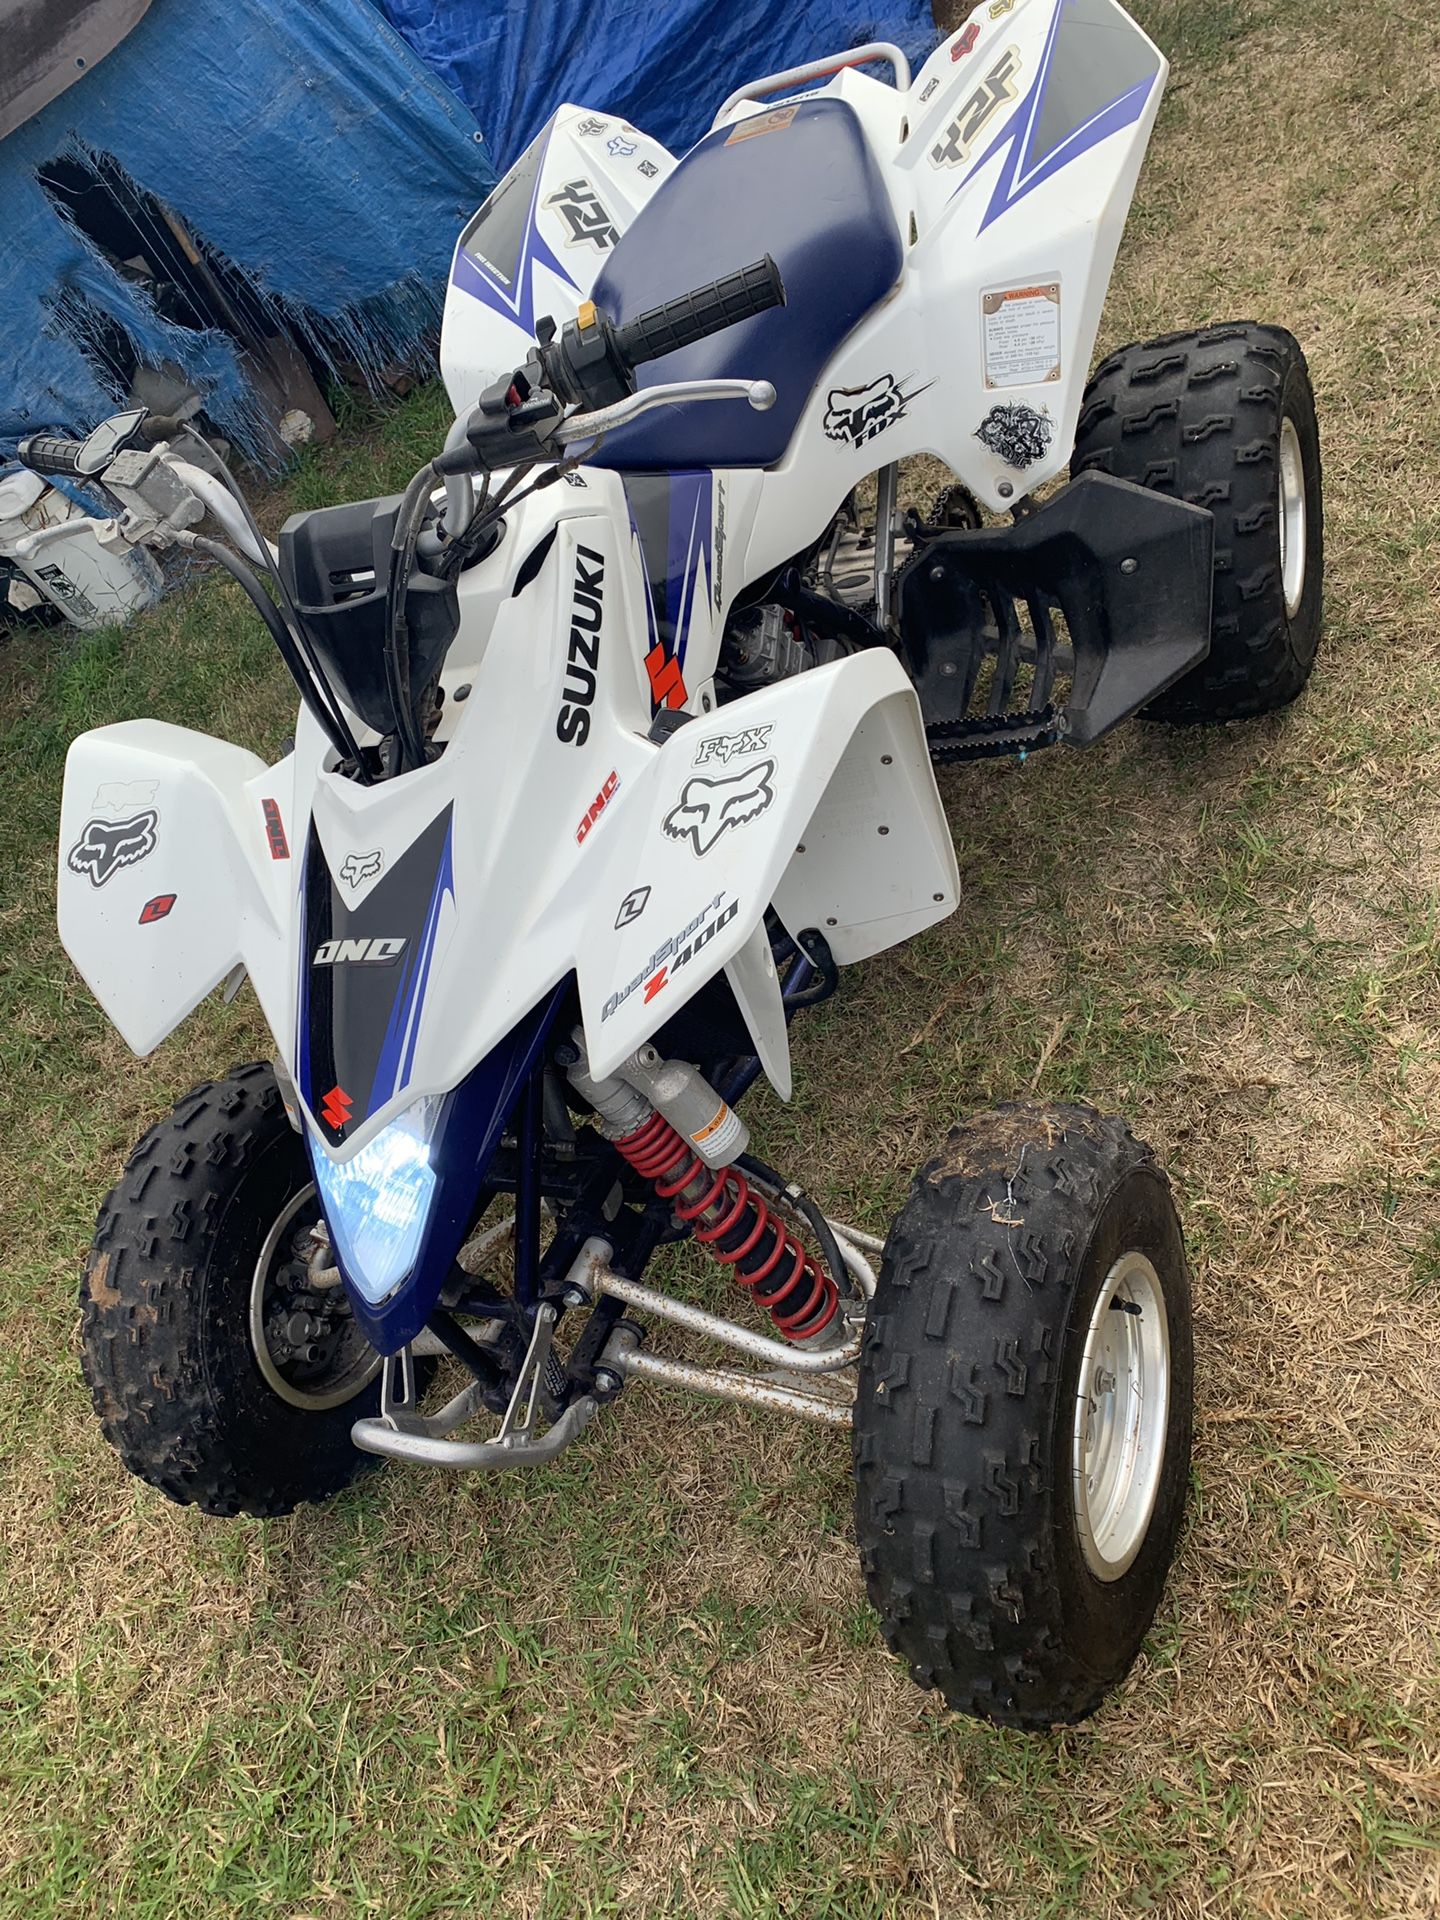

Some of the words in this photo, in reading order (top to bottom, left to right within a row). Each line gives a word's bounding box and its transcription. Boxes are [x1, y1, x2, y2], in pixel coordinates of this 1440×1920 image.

[1008, 288, 1040, 299] WARNING
[856, 403, 908, 449] FOX
[556, 544, 605, 747] SUZUKI
[601, 891, 726, 1022] QuadSport
